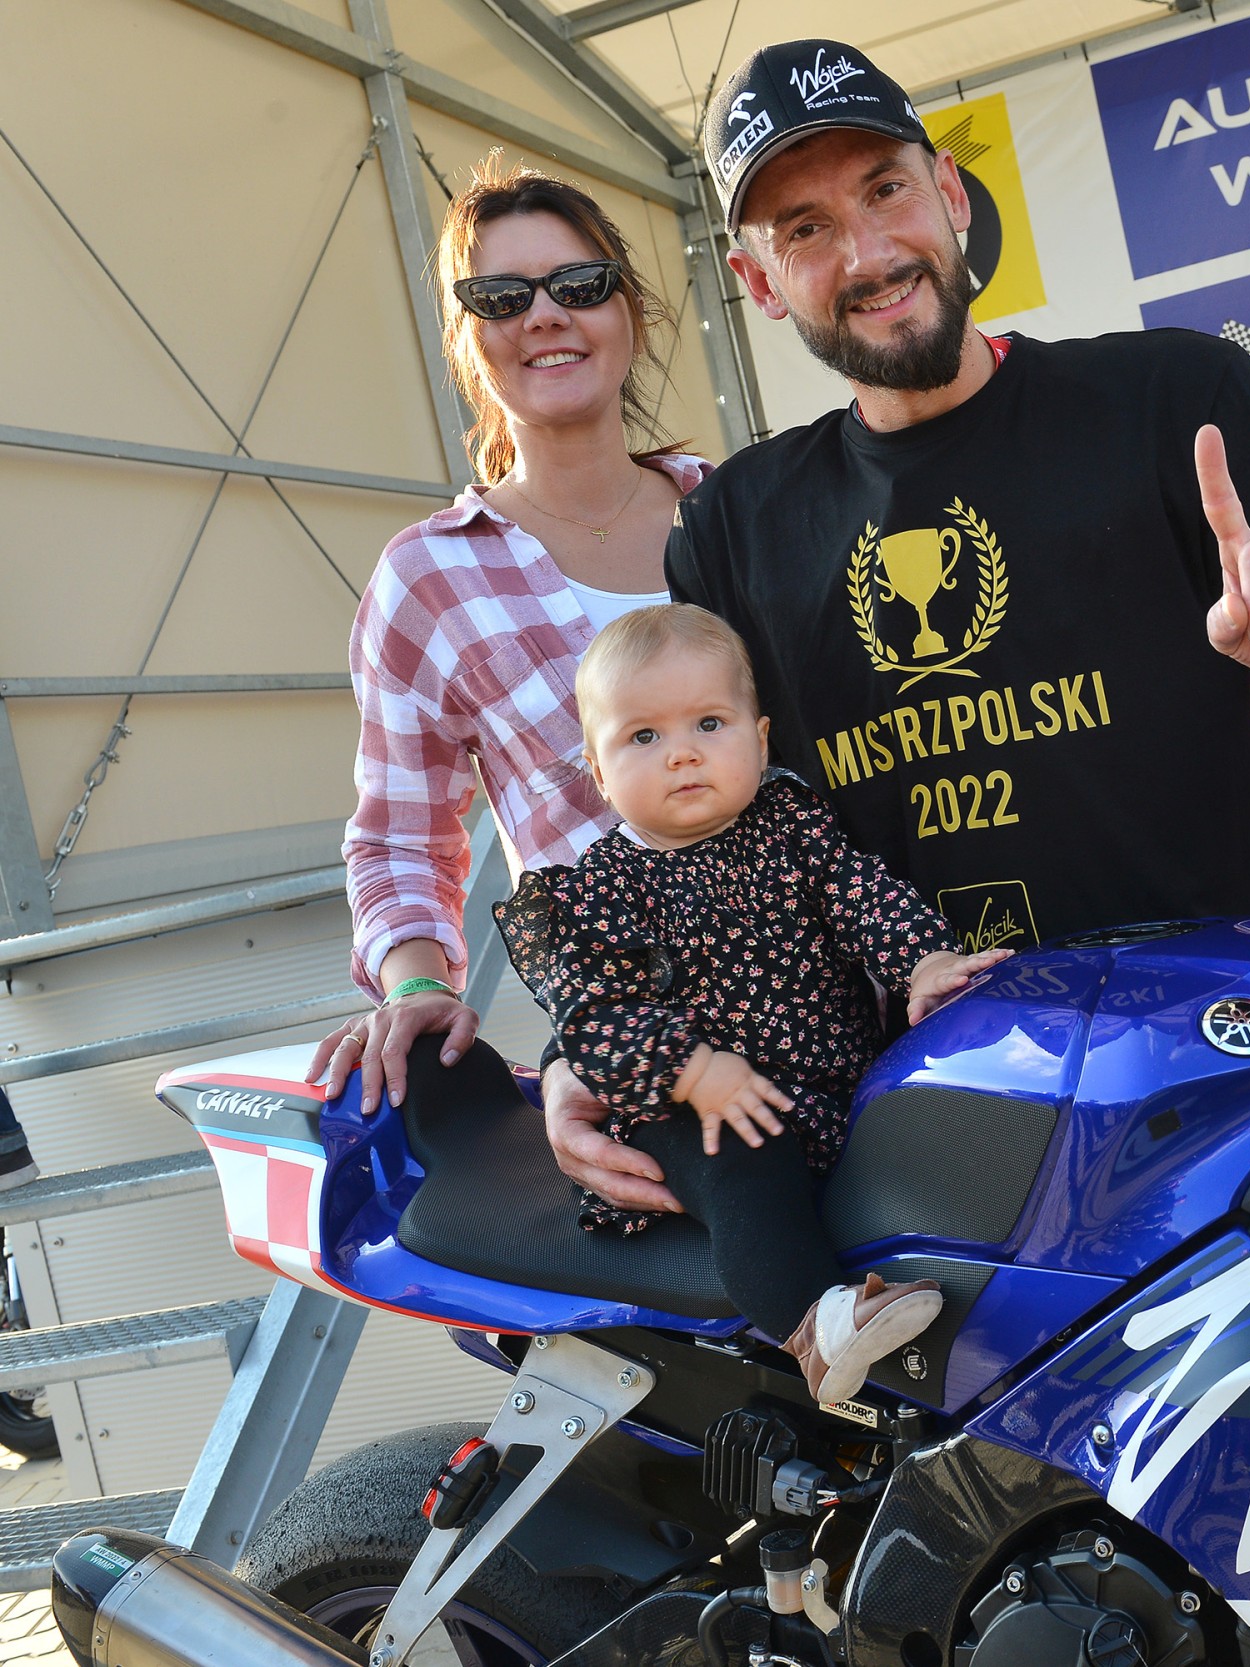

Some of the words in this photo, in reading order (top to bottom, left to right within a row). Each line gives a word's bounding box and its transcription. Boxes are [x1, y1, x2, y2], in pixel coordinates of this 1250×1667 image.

[790, 48, 865, 104] Wójcik
[806, 95, 848, 110] Racing
[851, 94, 880, 103] Team
[722, 115, 770, 175] ORLEN
[910, 770, 1020, 839] 2022
